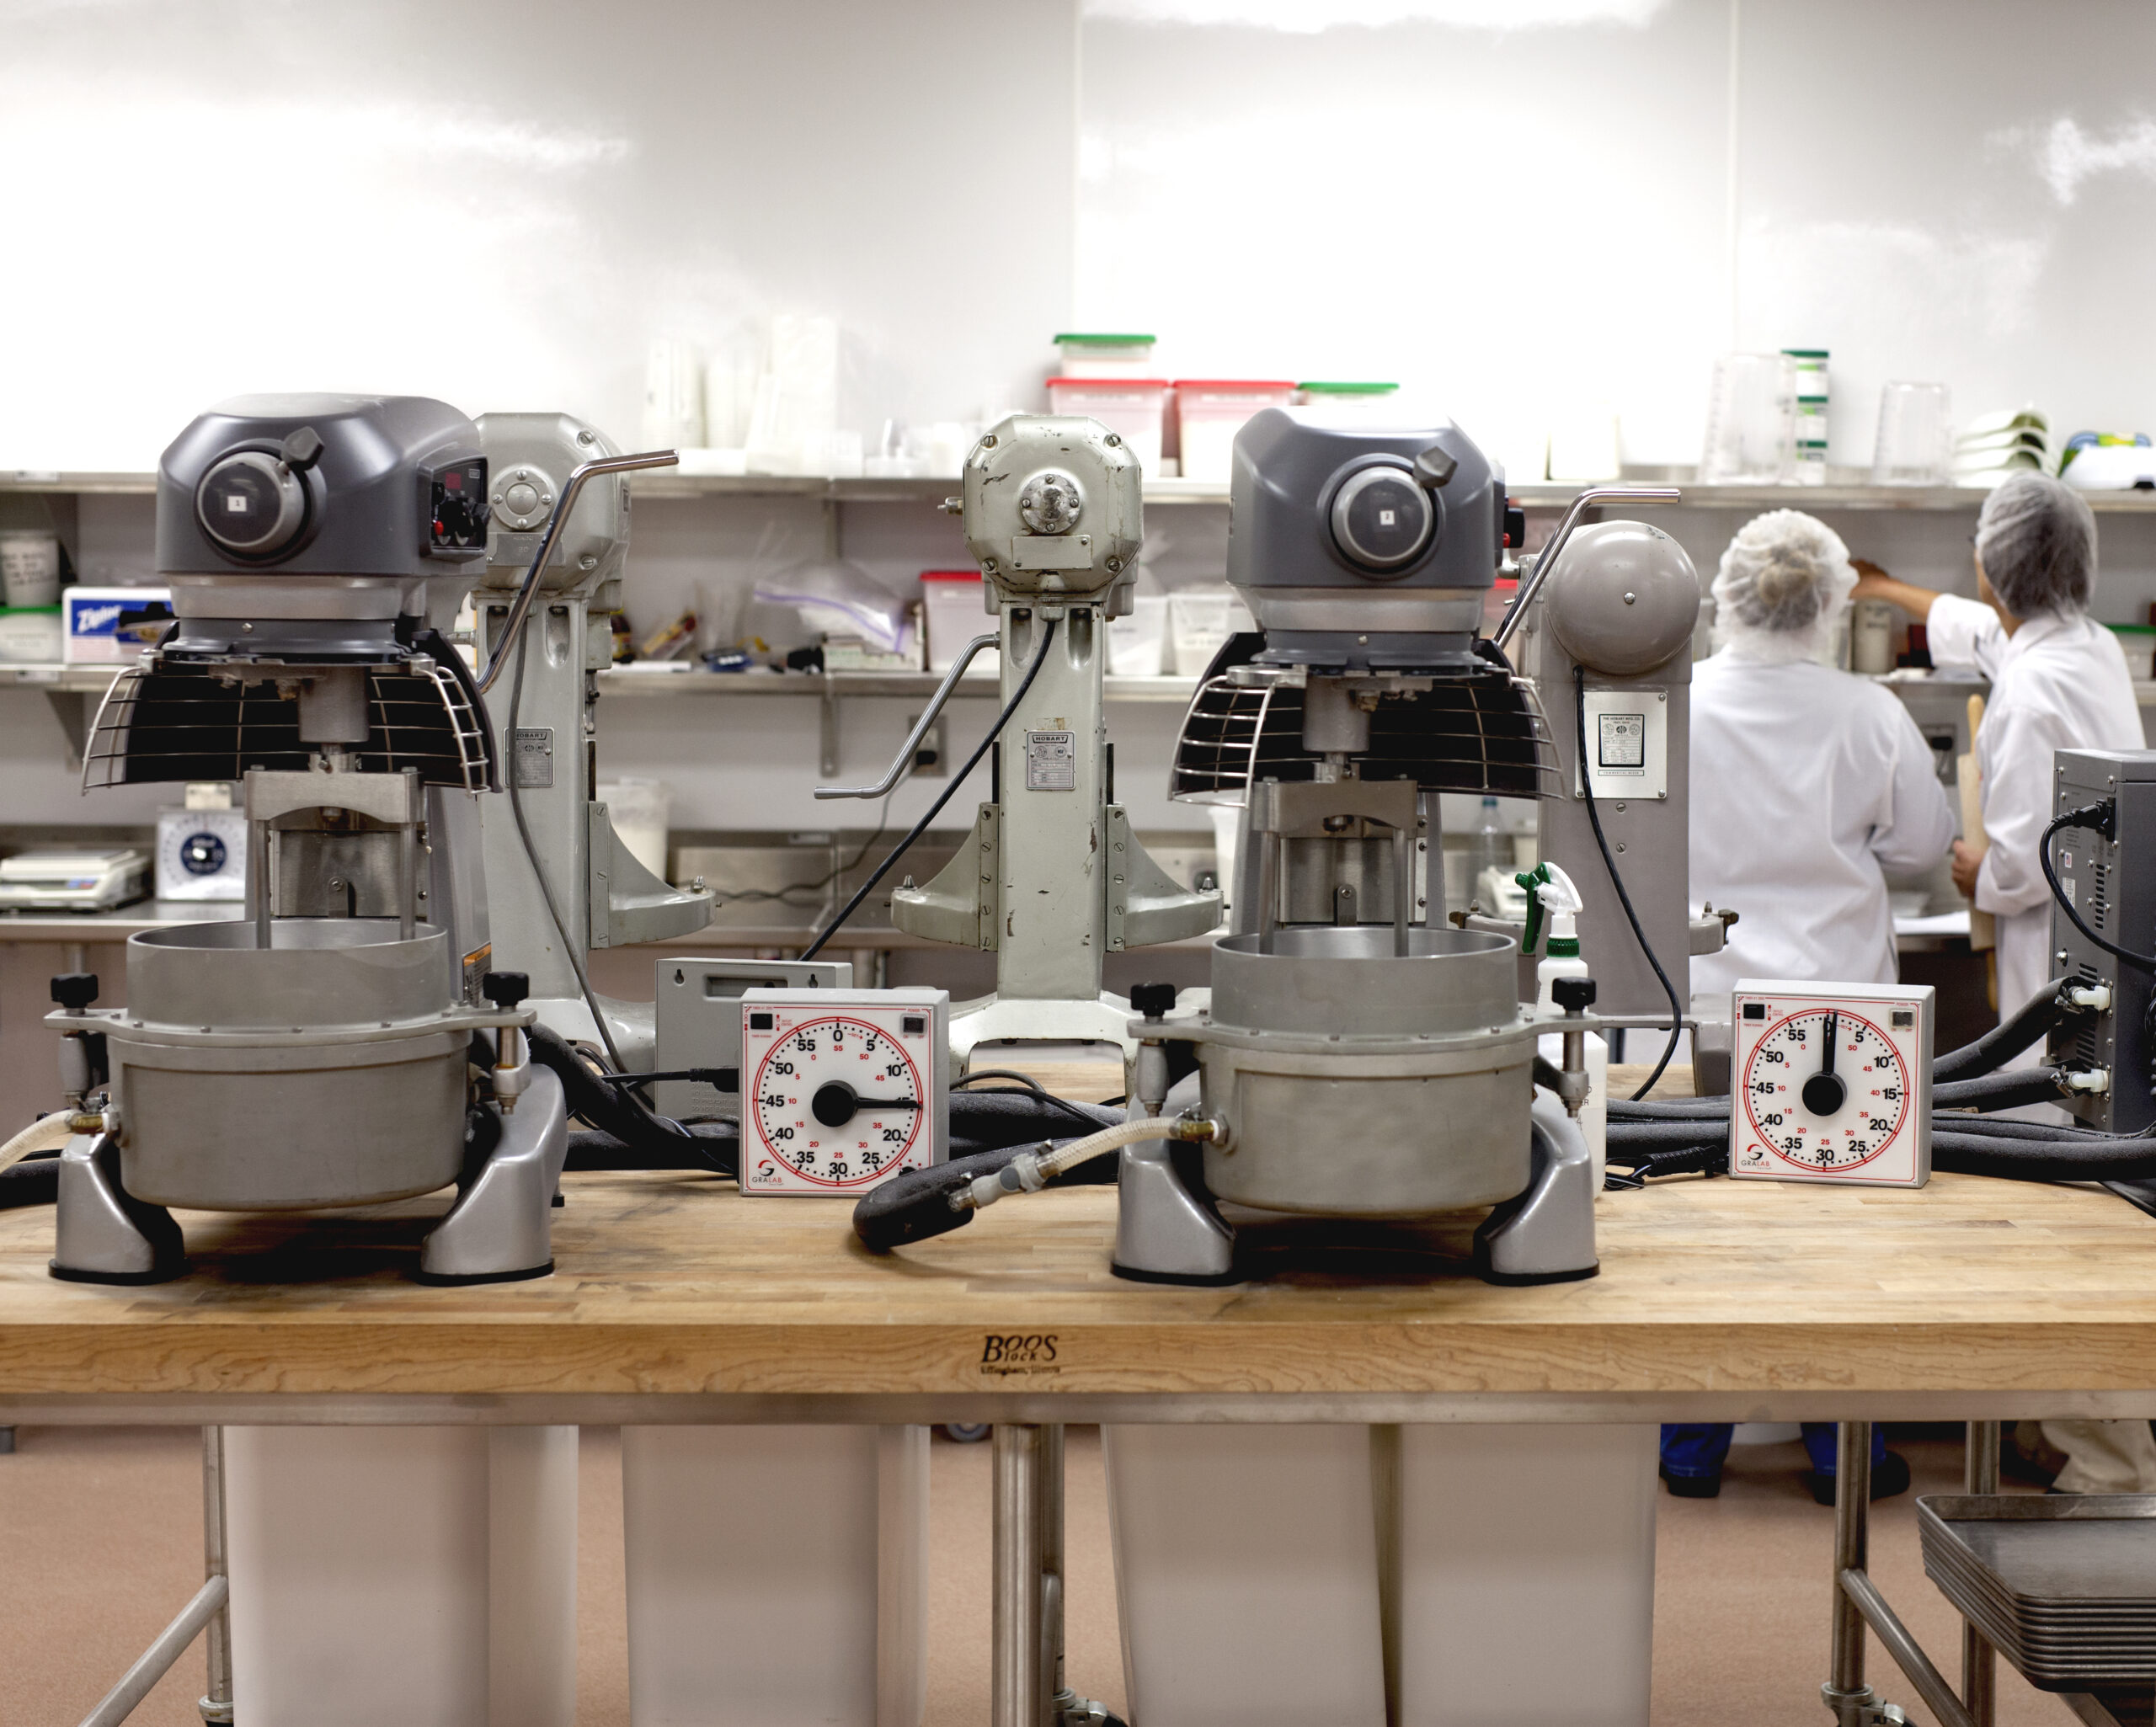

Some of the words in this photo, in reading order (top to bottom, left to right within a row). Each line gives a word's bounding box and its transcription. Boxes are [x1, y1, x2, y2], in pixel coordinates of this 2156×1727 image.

[833, 1030, 843, 1042] 0
[1788, 1030, 1806, 1041] 55
[1855, 1031, 1864, 1042] 5
[797, 1040, 815, 1052] 55
[867, 1040, 875, 1052] 5
[1766, 1051, 1784, 1063] 50
[1874, 1057, 1889, 1068] 10
[775, 1063, 793, 1074] 50
[886, 1065, 902, 1077] 10
[1756, 1083, 1774, 1094] 45
[1882, 1089, 1897, 1100] 15
[766, 1095, 785, 1107] 45
[1764, 1114, 1783, 1125] 40
[1870, 1119, 1887, 1131] 20
[775, 1127, 794, 1139] 40
[883, 1129, 901, 1142] 20
[1785, 1138, 1802, 1149] 35
[1849, 1141, 1866, 1153] 25
[797, 1151, 814, 1164] 35
[862, 1153, 880, 1165] 25
[1816, 1149, 1834, 1160] 30
[830, 1163, 848, 1175] 30
[981, 1335, 1059, 1362] BOOS
